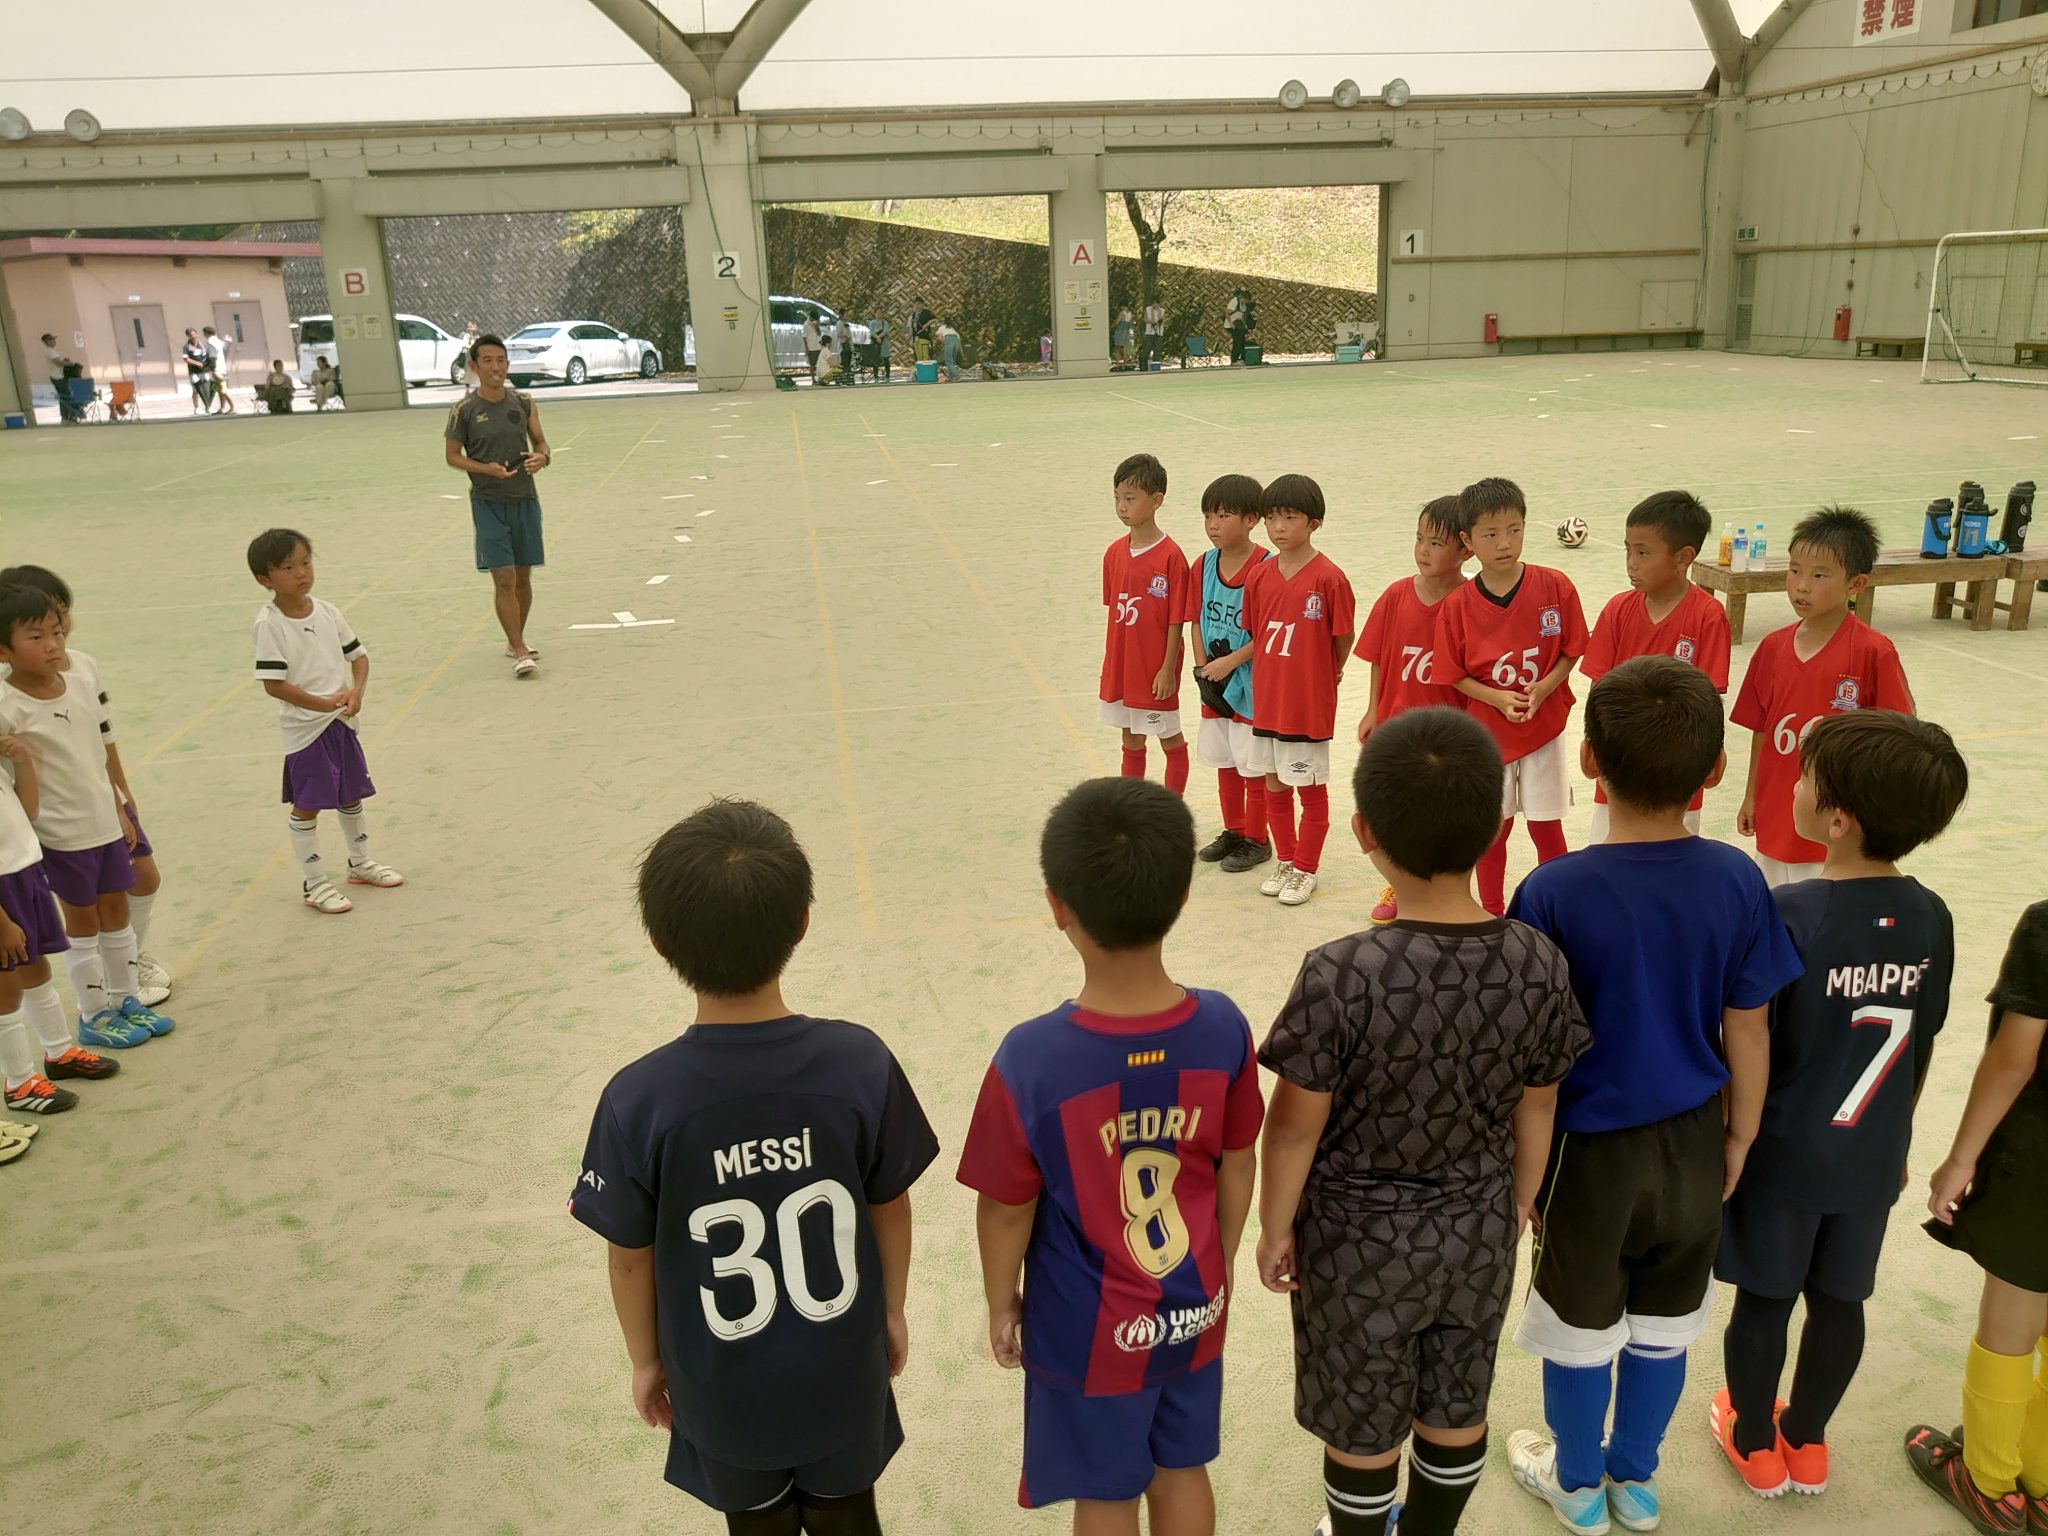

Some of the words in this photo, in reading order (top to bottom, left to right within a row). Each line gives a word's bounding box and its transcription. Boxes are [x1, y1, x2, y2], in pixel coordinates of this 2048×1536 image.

[1072, 244, 1092, 264] A
[1406, 233, 1414, 254] 1
[345, 272, 365, 294] B
[718, 256, 737, 277] 2
[1115, 592, 1142, 626] 56
[1265, 620, 1296, 657] 71
[1401, 645, 1434, 684] 76
[1491, 646, 1540, 687] 65
[1825, 957, 1930, 998] MBAPPÉ
[1830, 1005, 1914, 1127] 7
[1099, 1106, 1202, 1158] PEDRI
[1119, 1147, 1190, 1280] 8
[688, 1178, 860, 1341] 30
